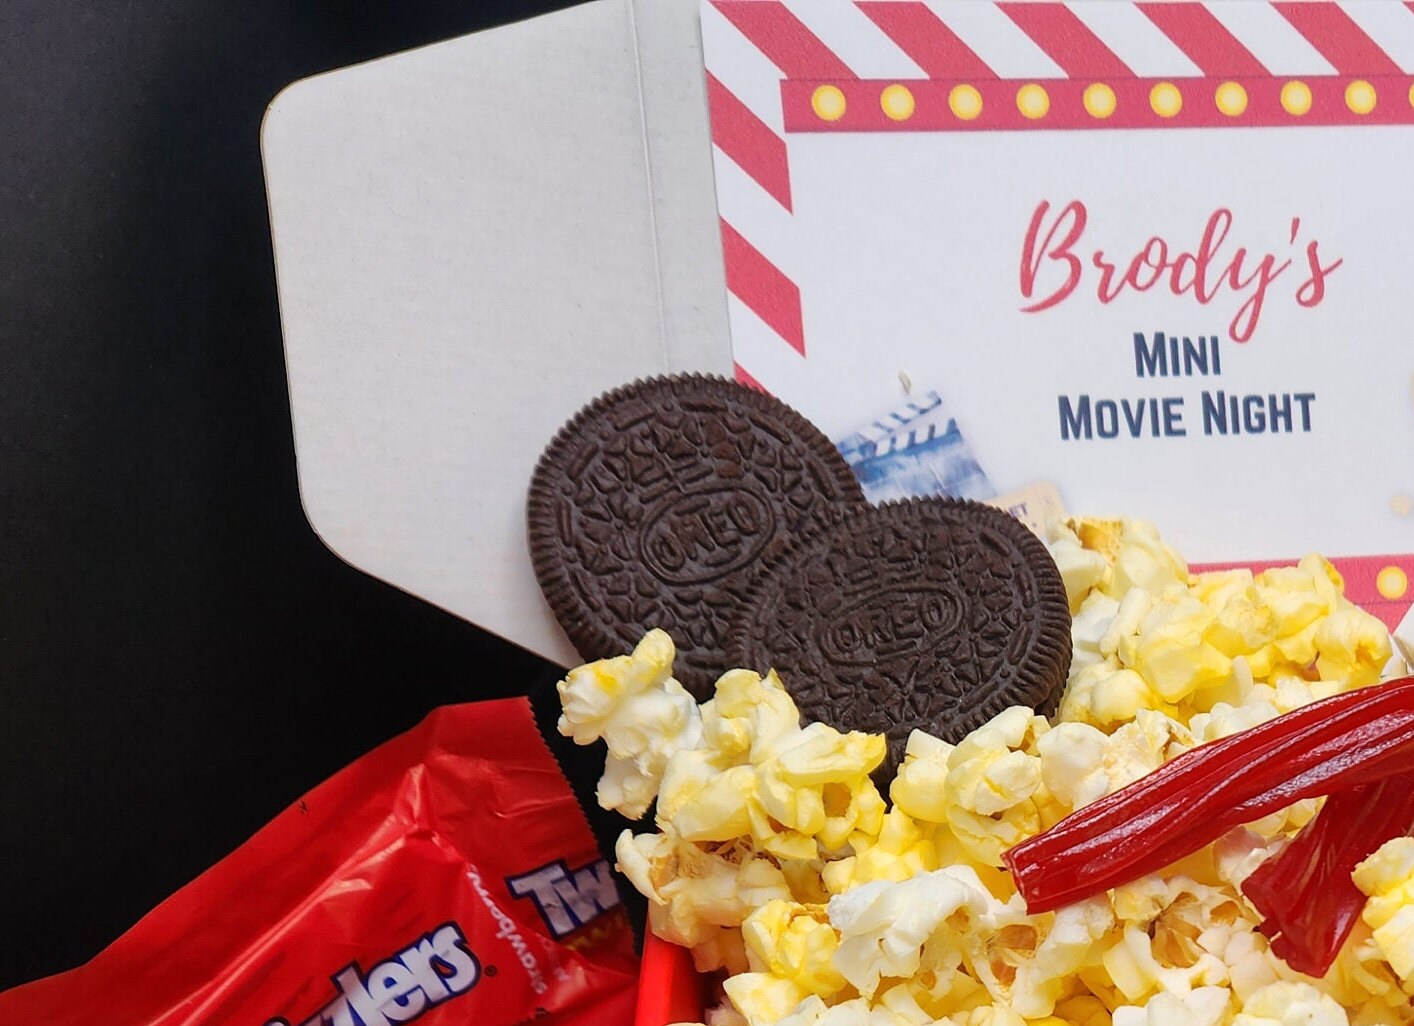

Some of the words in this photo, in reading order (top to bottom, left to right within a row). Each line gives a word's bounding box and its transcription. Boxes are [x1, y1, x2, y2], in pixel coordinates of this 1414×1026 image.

[1018, 199, 1343, 343] Brody's
[1133, 332, 1221, 378] MINI
[1058, 394, 1186, 442] MOVIE
[1202, 391, 1317, 437] NIGHT
